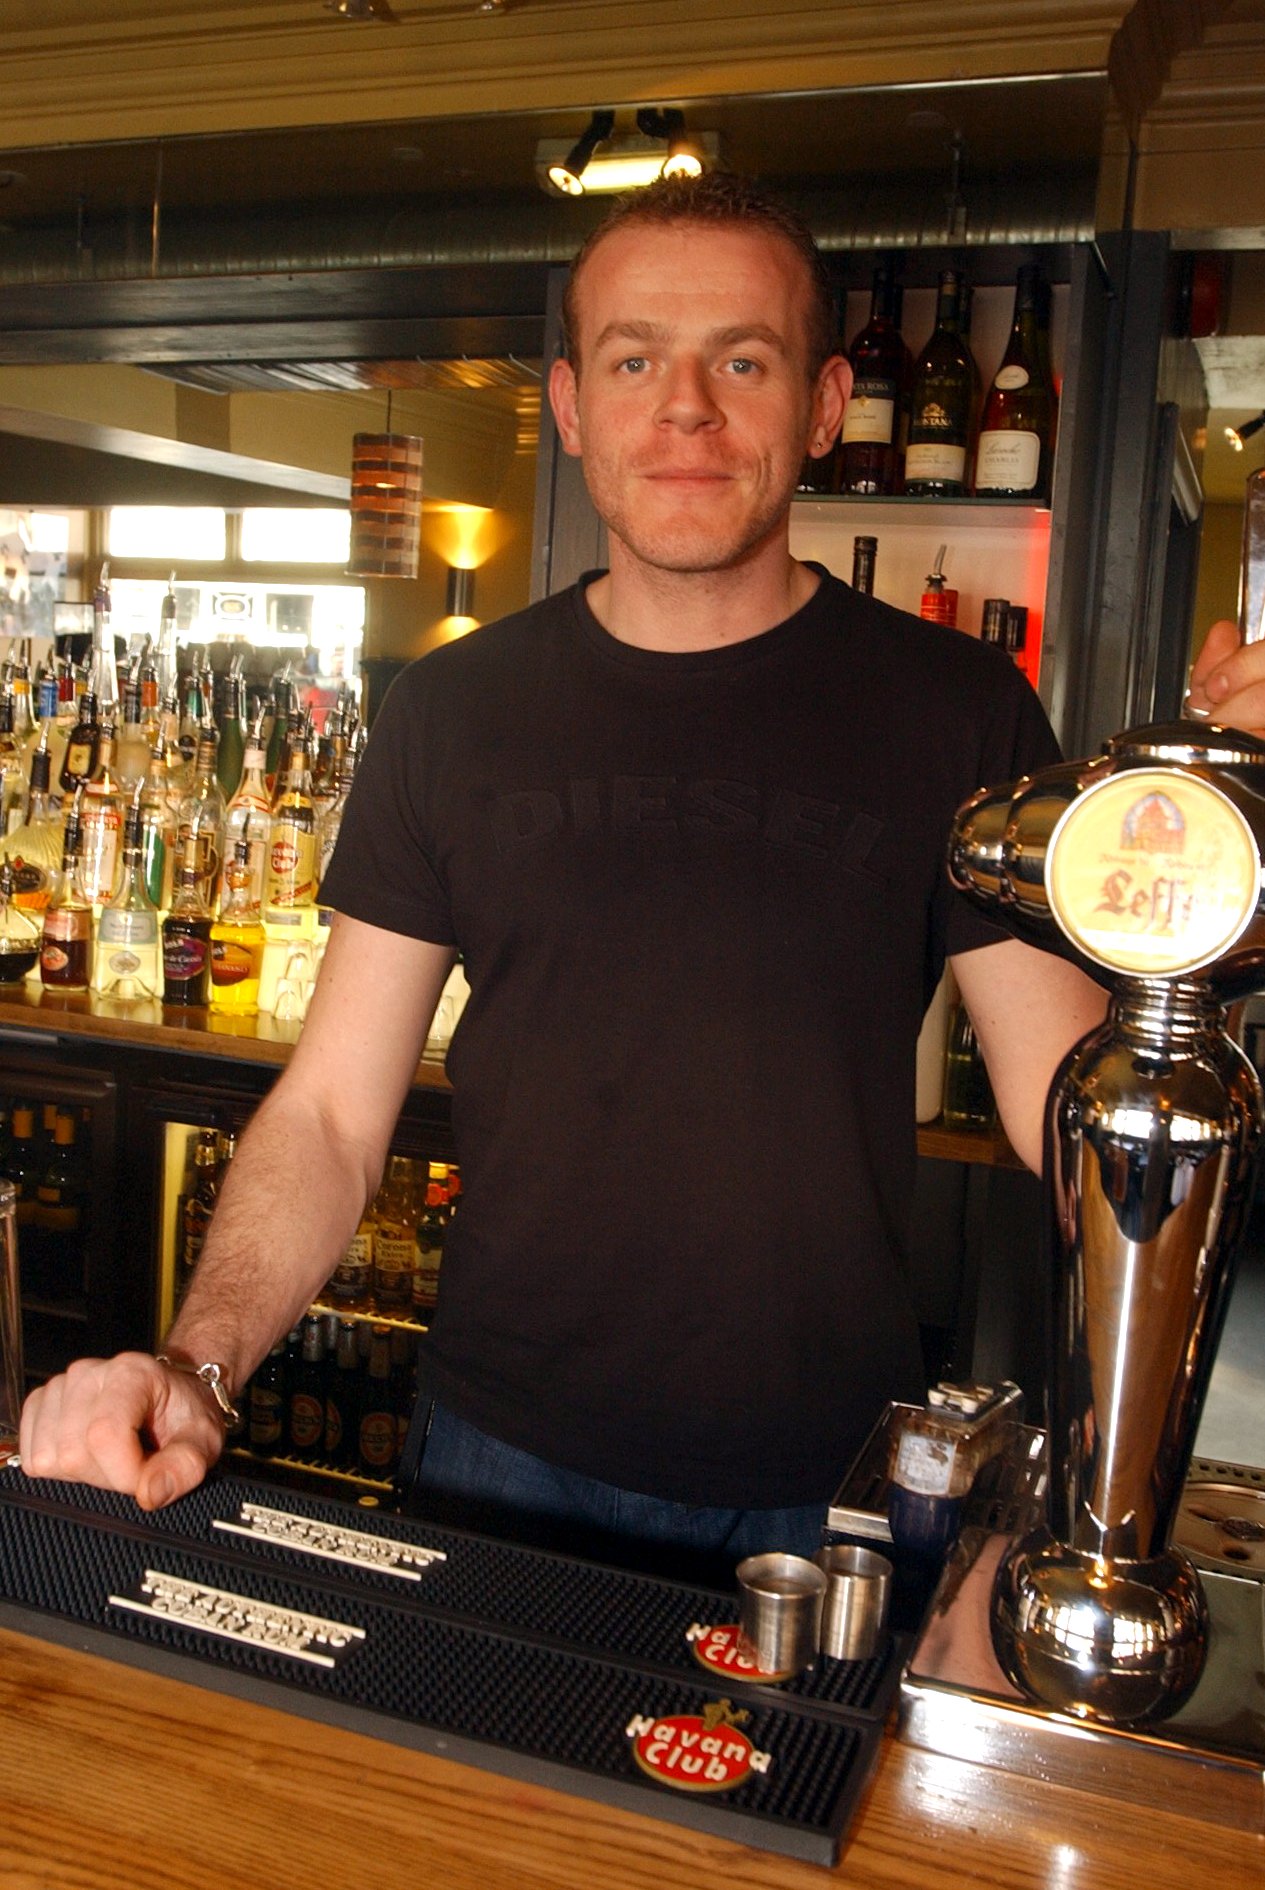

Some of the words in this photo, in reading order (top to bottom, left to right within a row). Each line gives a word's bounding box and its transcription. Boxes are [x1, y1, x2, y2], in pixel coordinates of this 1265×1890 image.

[488, 775, 888, 887] DIESEL
[705, 1645, 774, 1674] Clu
[626, 1714, 772, 1773] Havana
[645, 1741, 728, 1781] Club
